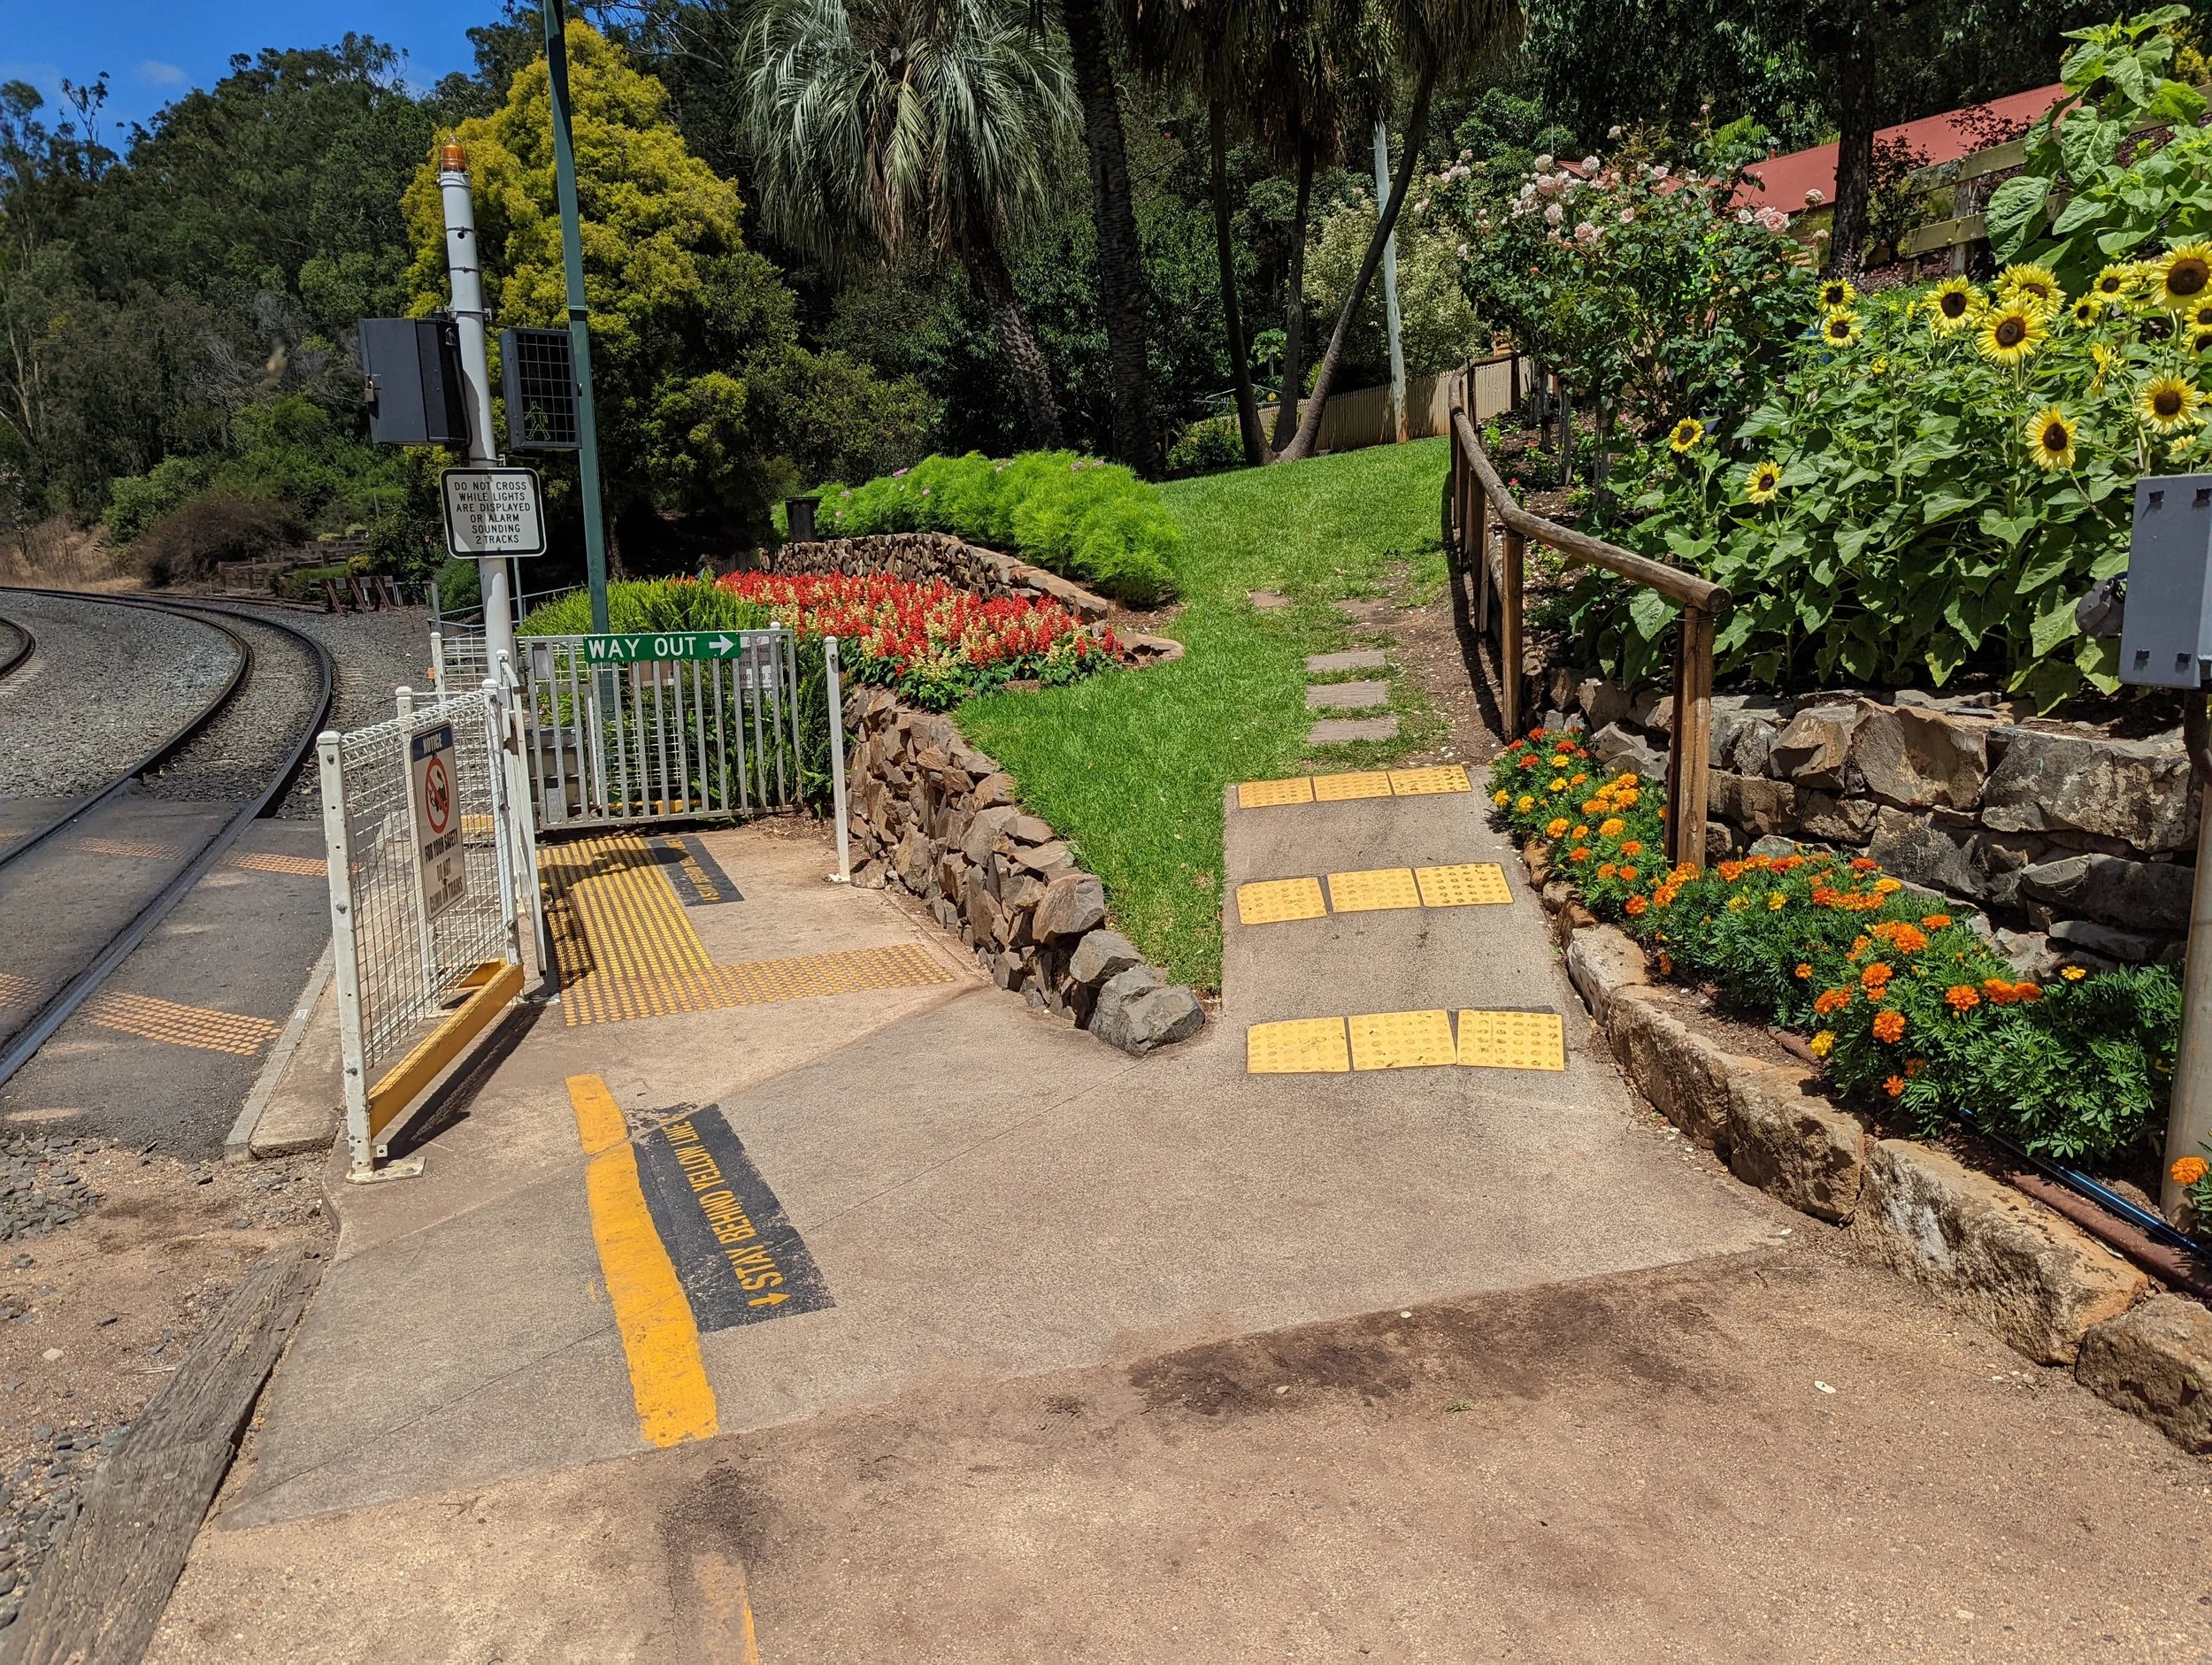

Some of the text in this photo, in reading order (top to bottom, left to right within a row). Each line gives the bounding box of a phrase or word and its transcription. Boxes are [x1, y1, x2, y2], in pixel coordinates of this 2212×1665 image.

[454, 481, 526, 491] DO NOT CROSS
[459, 492, 525, 502] WHILE LIGHTS
[456, 503, 531, 512] ARE DISPLAYED
[470, 513, 519, 523] OR ALARM
[472, 524, 520, 533] SOUNDING
[475, 534, 519, 544] 2 TRACKS
[588, 636, 697, 659] WAY OUT
[422, 733, 442, 754] NOTICE
[425, 842, 434, 863] FOR
[444, 827, 458, 851] SAFETY
[661, 1120, 784, 1291] STAY BEHIND YELLOW LINE
